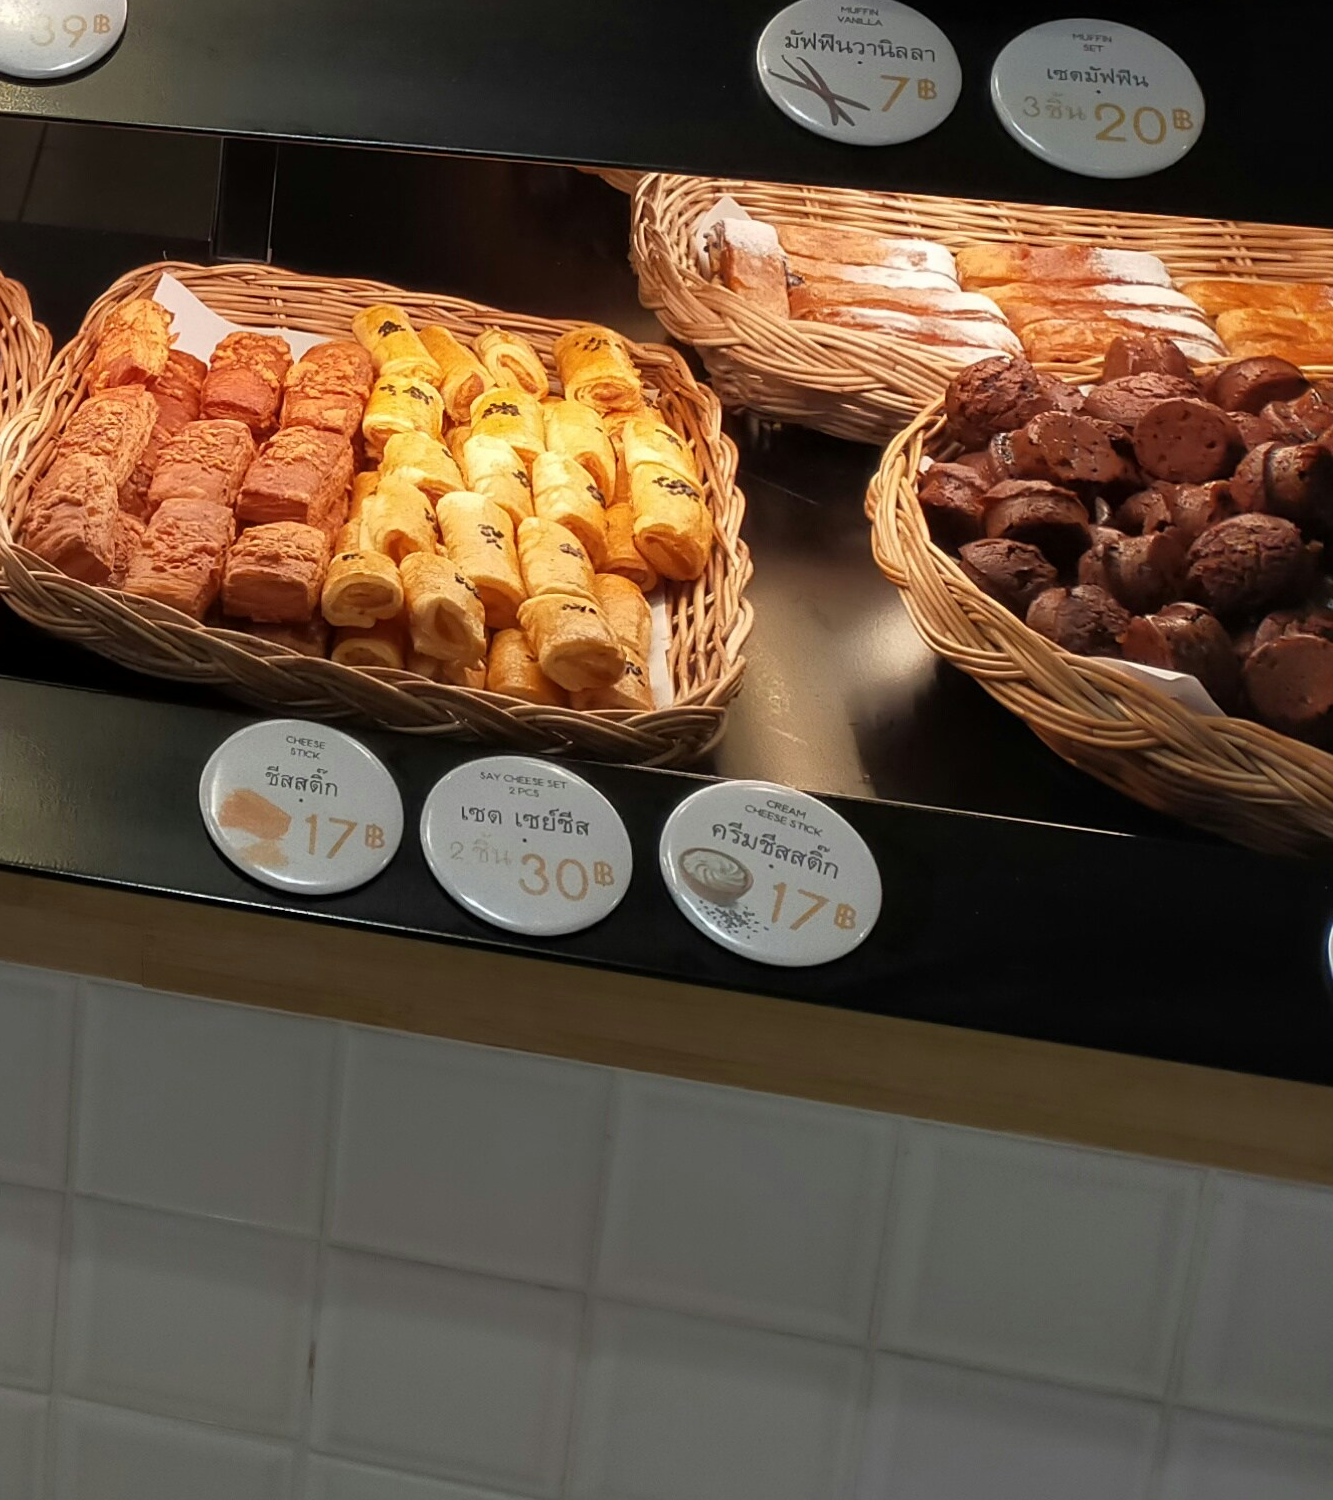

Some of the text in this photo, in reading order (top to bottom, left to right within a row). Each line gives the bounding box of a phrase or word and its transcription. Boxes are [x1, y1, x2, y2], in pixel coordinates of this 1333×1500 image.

[840, 6, 879, 16] MUFFIN
[837, 16, 883, 27] VANILLA
[1071, 33, 1112, 43] MUFFIN
[1082, 44, 1105, 53] SET
[1022, 95, 1041, 118] 3
[285, 734, 326, 750] CHEESE
[290, 747, 322, 760] STICK
[479, 770, 568, 790] SAY CHEESE SET
[765, 798, 807, 819] CREAM
[744, 803, 824, 839] CHEESE STICK
[449, 841, 464, 861] 2
